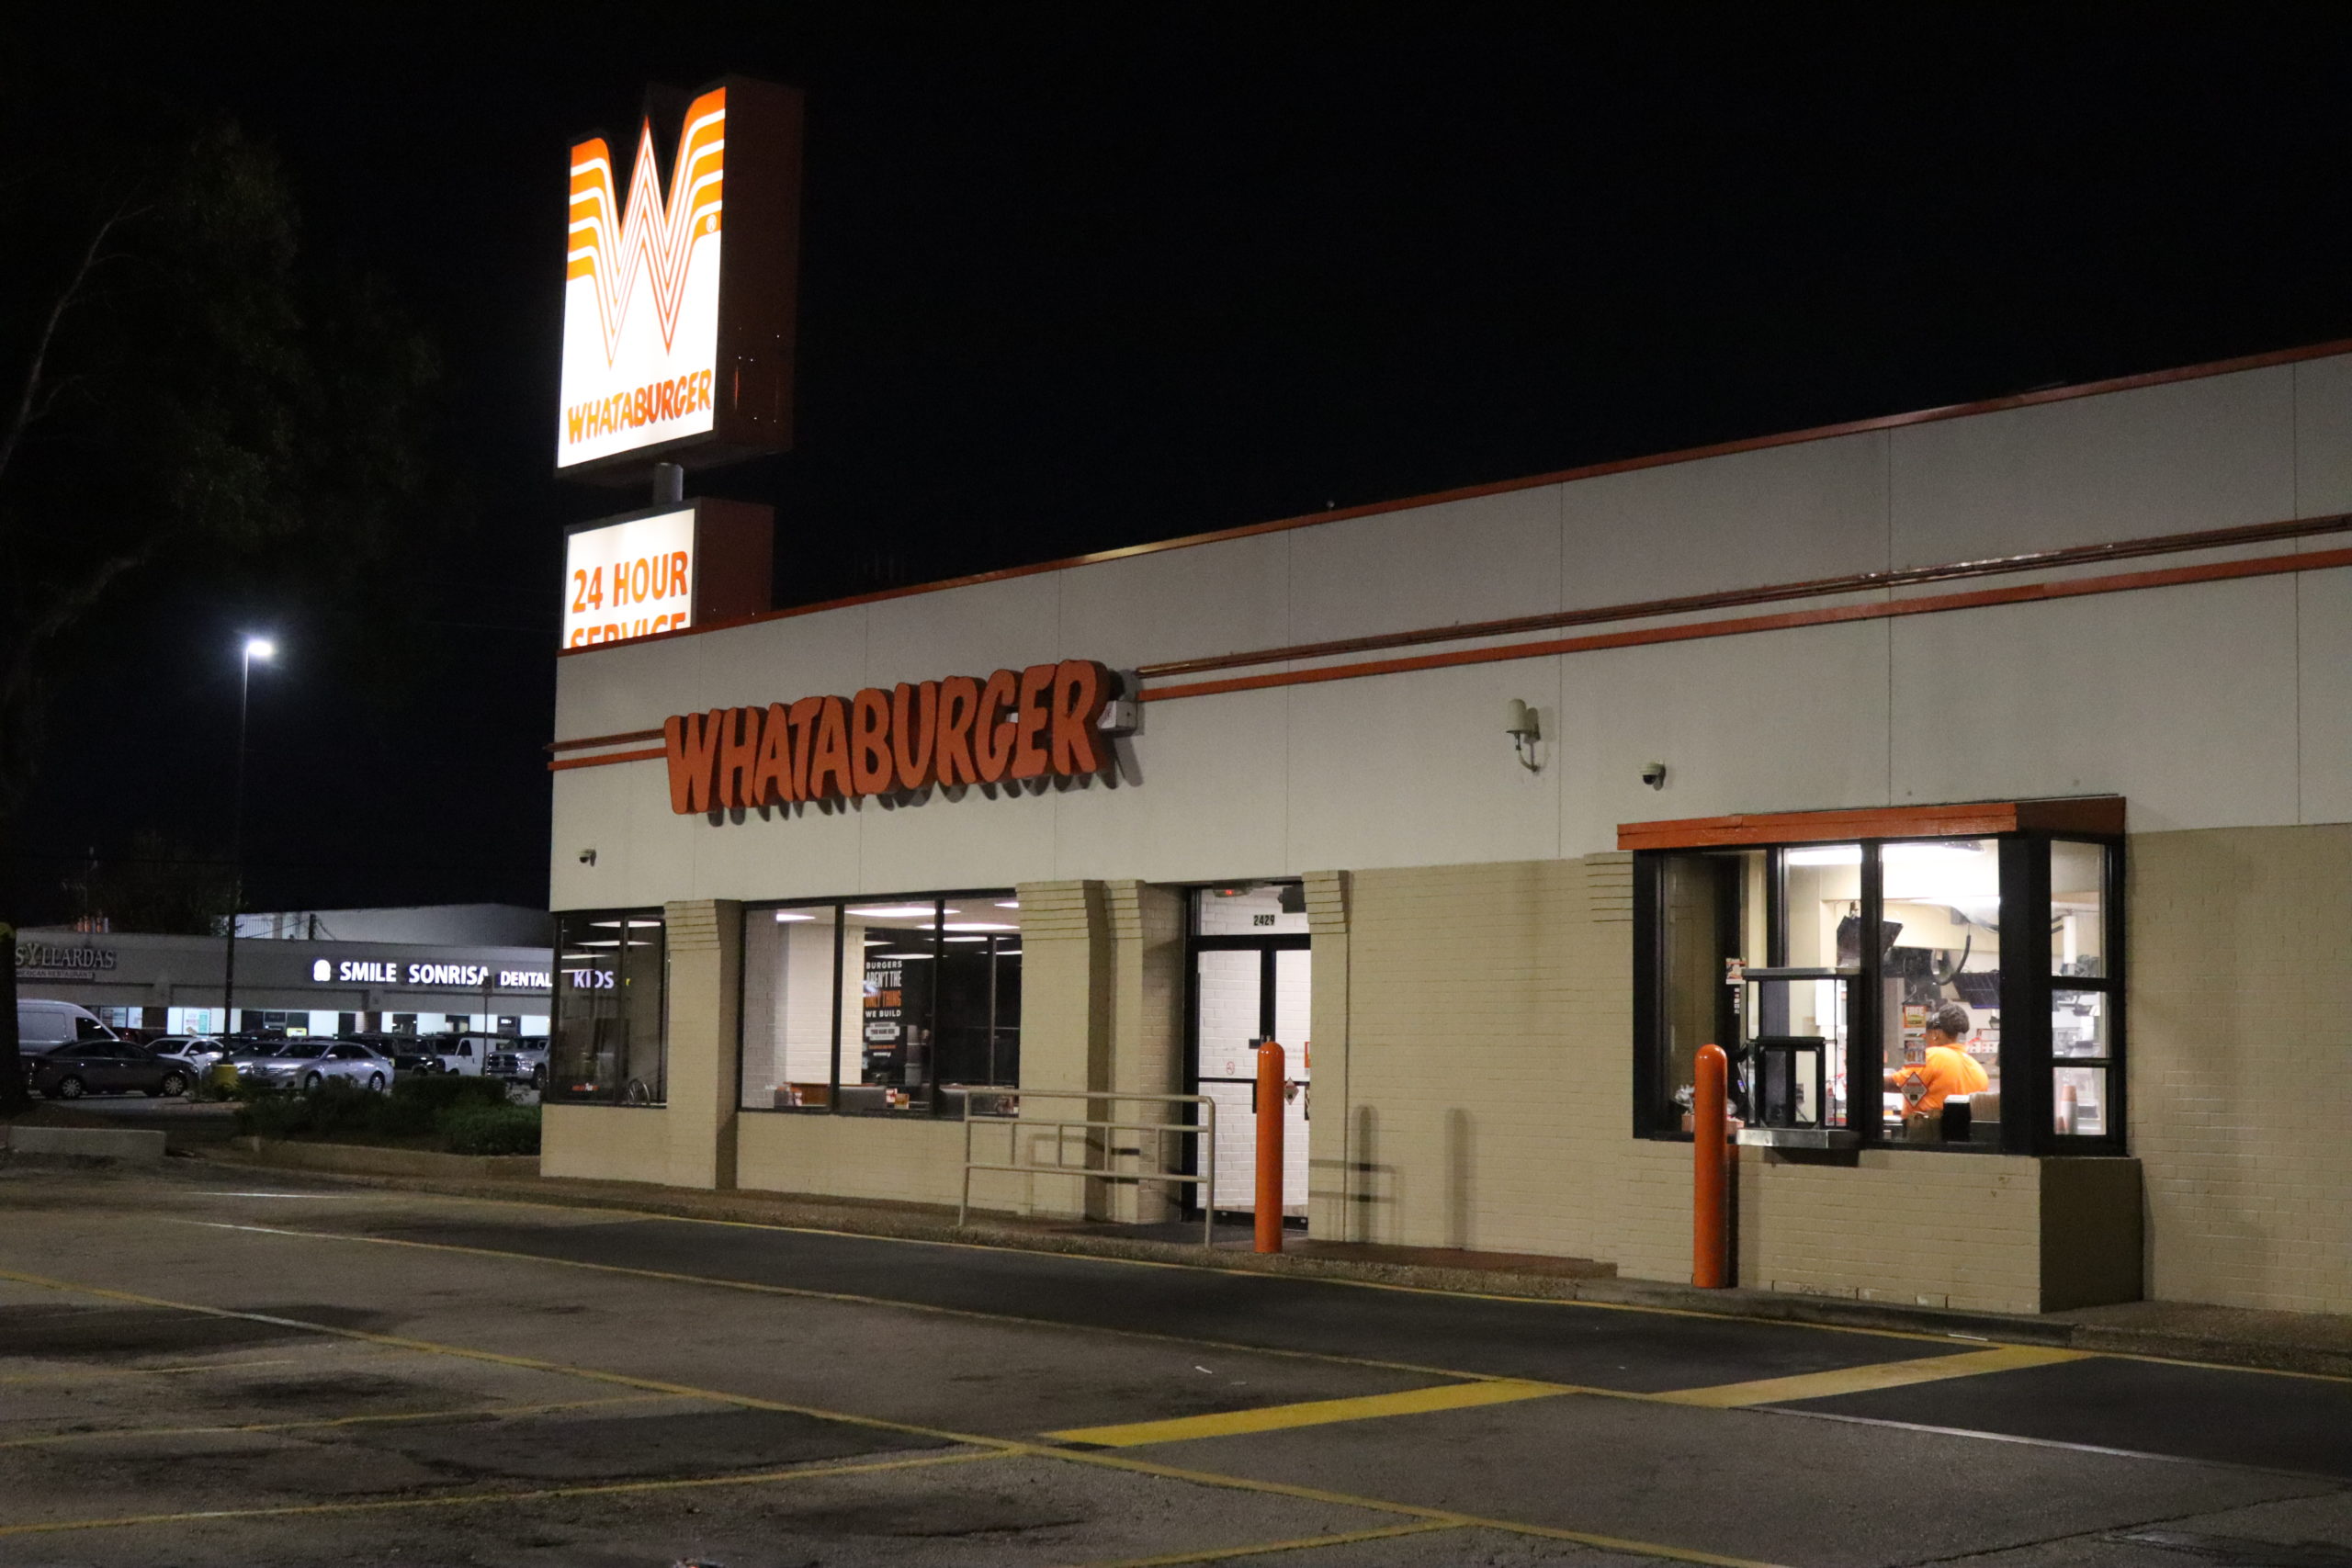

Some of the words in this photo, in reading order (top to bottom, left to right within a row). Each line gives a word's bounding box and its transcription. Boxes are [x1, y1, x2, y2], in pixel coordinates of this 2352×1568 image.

[568, 368, 712, 445] WHATABURGER
[572, 567, 604, 614] 24
[613, 551, 688, 607] HOUR
[663, 660, 1099, 815] WHATABURGER
[1253, 914, 1275, 926] 2429
[339, 962, 397, 983] SMILE
[409, 964, 488, 986] SONRISA
[501, 971, 552, 987] DENTAL
[574, 971, 614, 989] KIDS
[865, 961, 902, 969] BURGERS
[889, 971, 902, 987] THE
